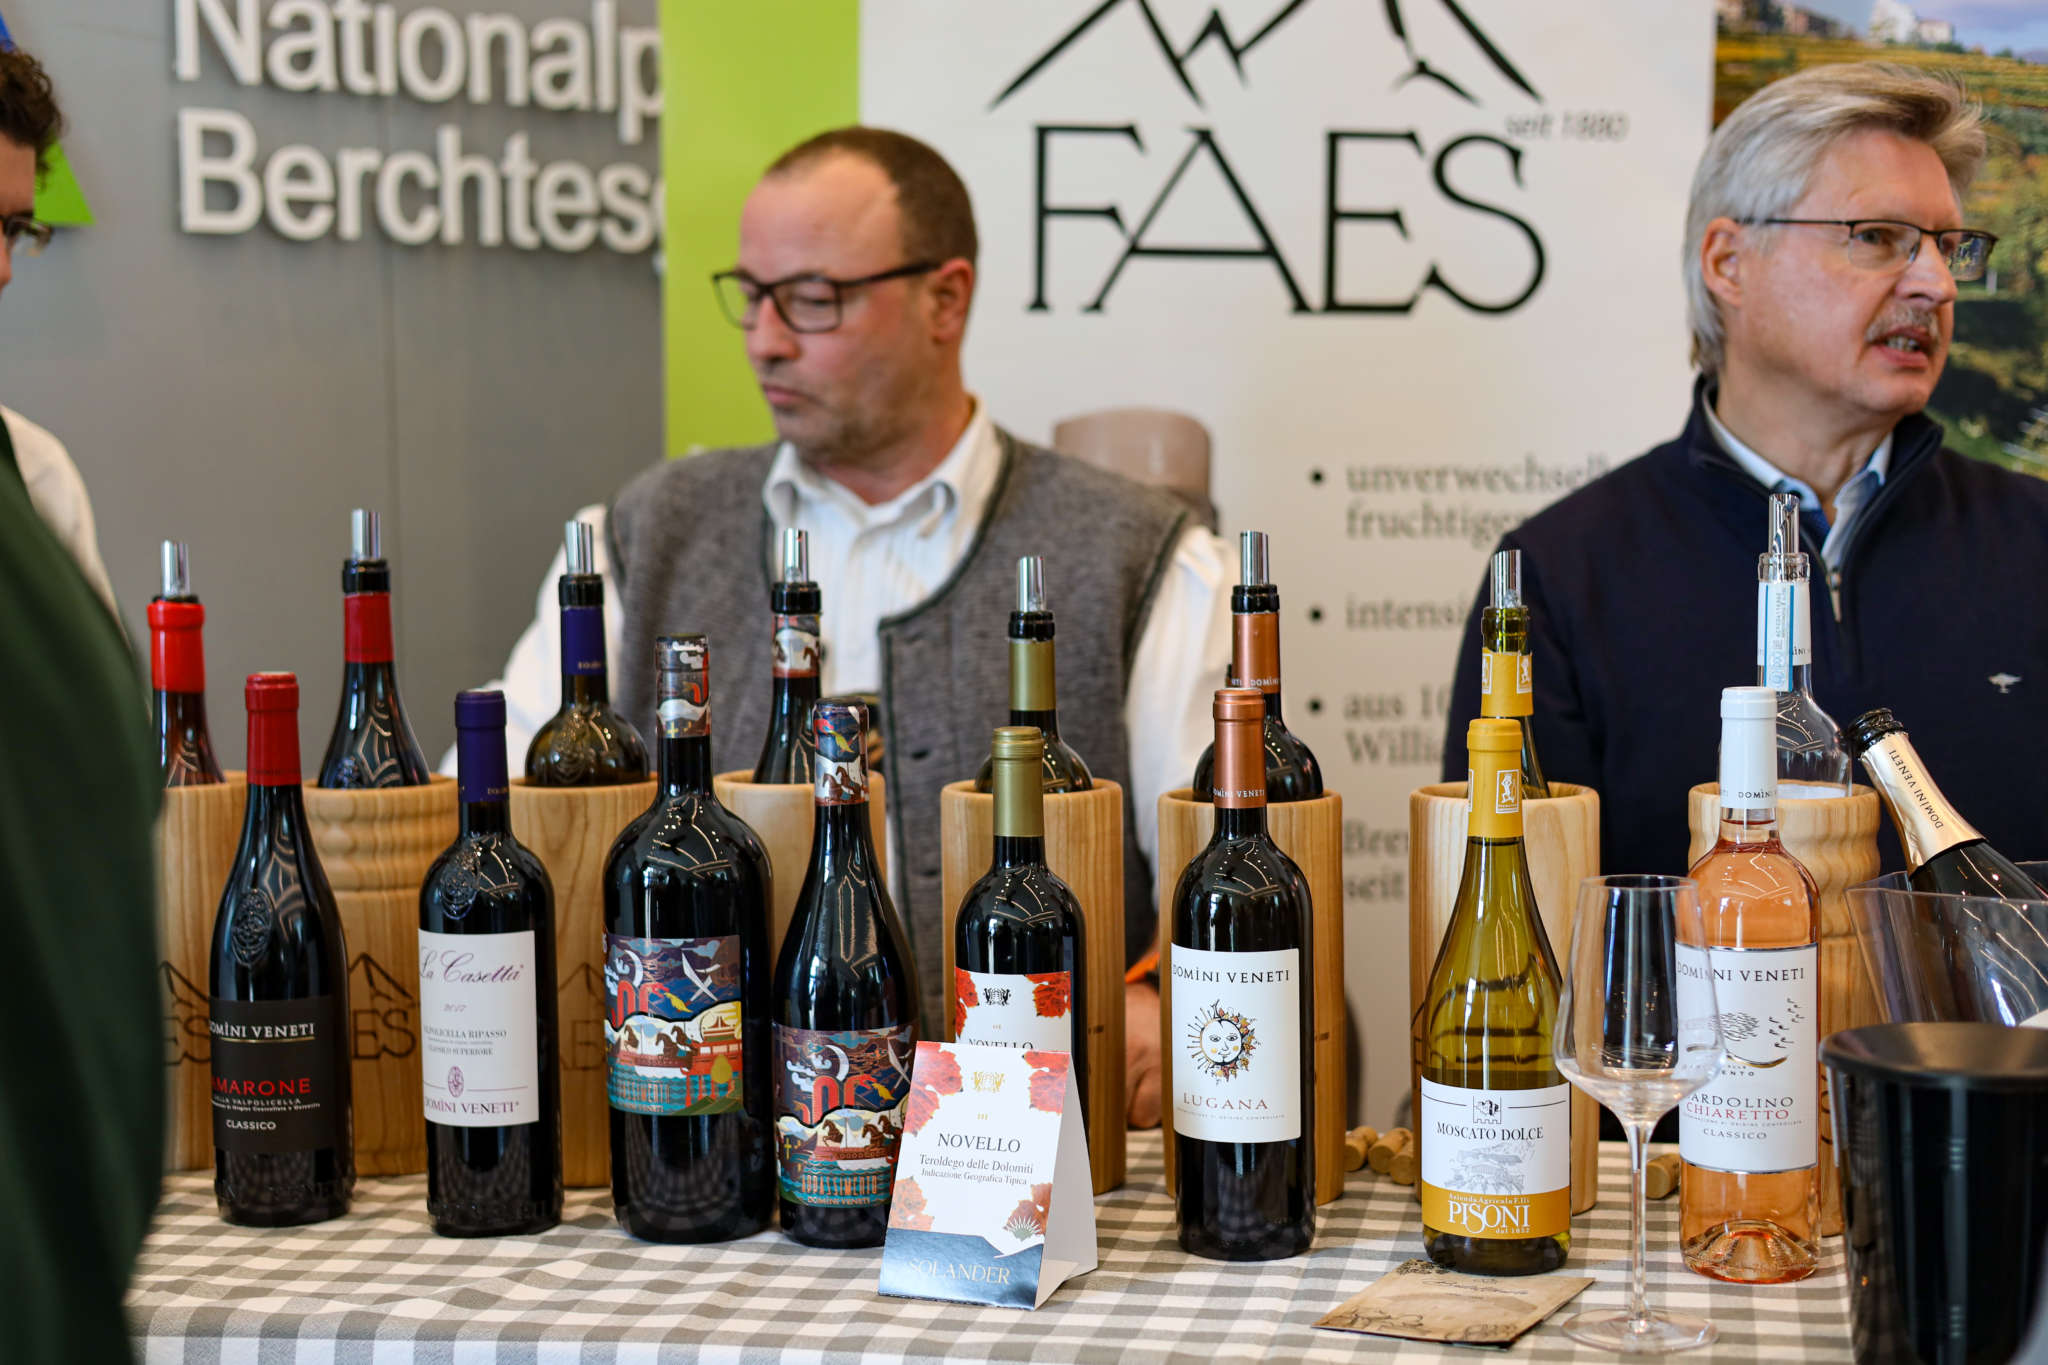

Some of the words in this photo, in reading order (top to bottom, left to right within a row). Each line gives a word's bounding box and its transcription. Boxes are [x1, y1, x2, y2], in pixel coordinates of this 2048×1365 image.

[1504, 112, 1552, 140] seit
[1026, 121, 1546, 317] FAES
[1346, 500, 1525, 552] fruchtige
[1345, 692, 1402, 721] aus
[1888, 749, 1917, 788] VENETI
[1227, 969, 1289, 984] VENETI
[1740, 967, 1804, 982] VENETI
[251, 1022, 315, 1038] VENETI
[461, 1102, 514, 1114] VENETI
[1184, 1092, 1268, 1110] LUGANA
[1688, 1093, 1794, 1109] ARDOLINO
[1686, 1102, 1790, 1121] CHIARETTO
[226, 1119, 277, 1130] CLASSICO
[1437, 1121, 1496, 1140] MOSCATO
[1501, 1126, 1544, 1141] DOLCE
[1703, 1128, 1767, 1140] CLASSICO
[937, 1132, 1021, 1153] NOVELLO
[919, 1153, 965, 1169] Teroldego
[966, 1158, 990, 1170] delle
[992, 1160, 1034, 1174] Dolomiti
[1448, 1200, 1531, 1234] PISONI
[908, 1258, 1011, 1286] SOLANDER
